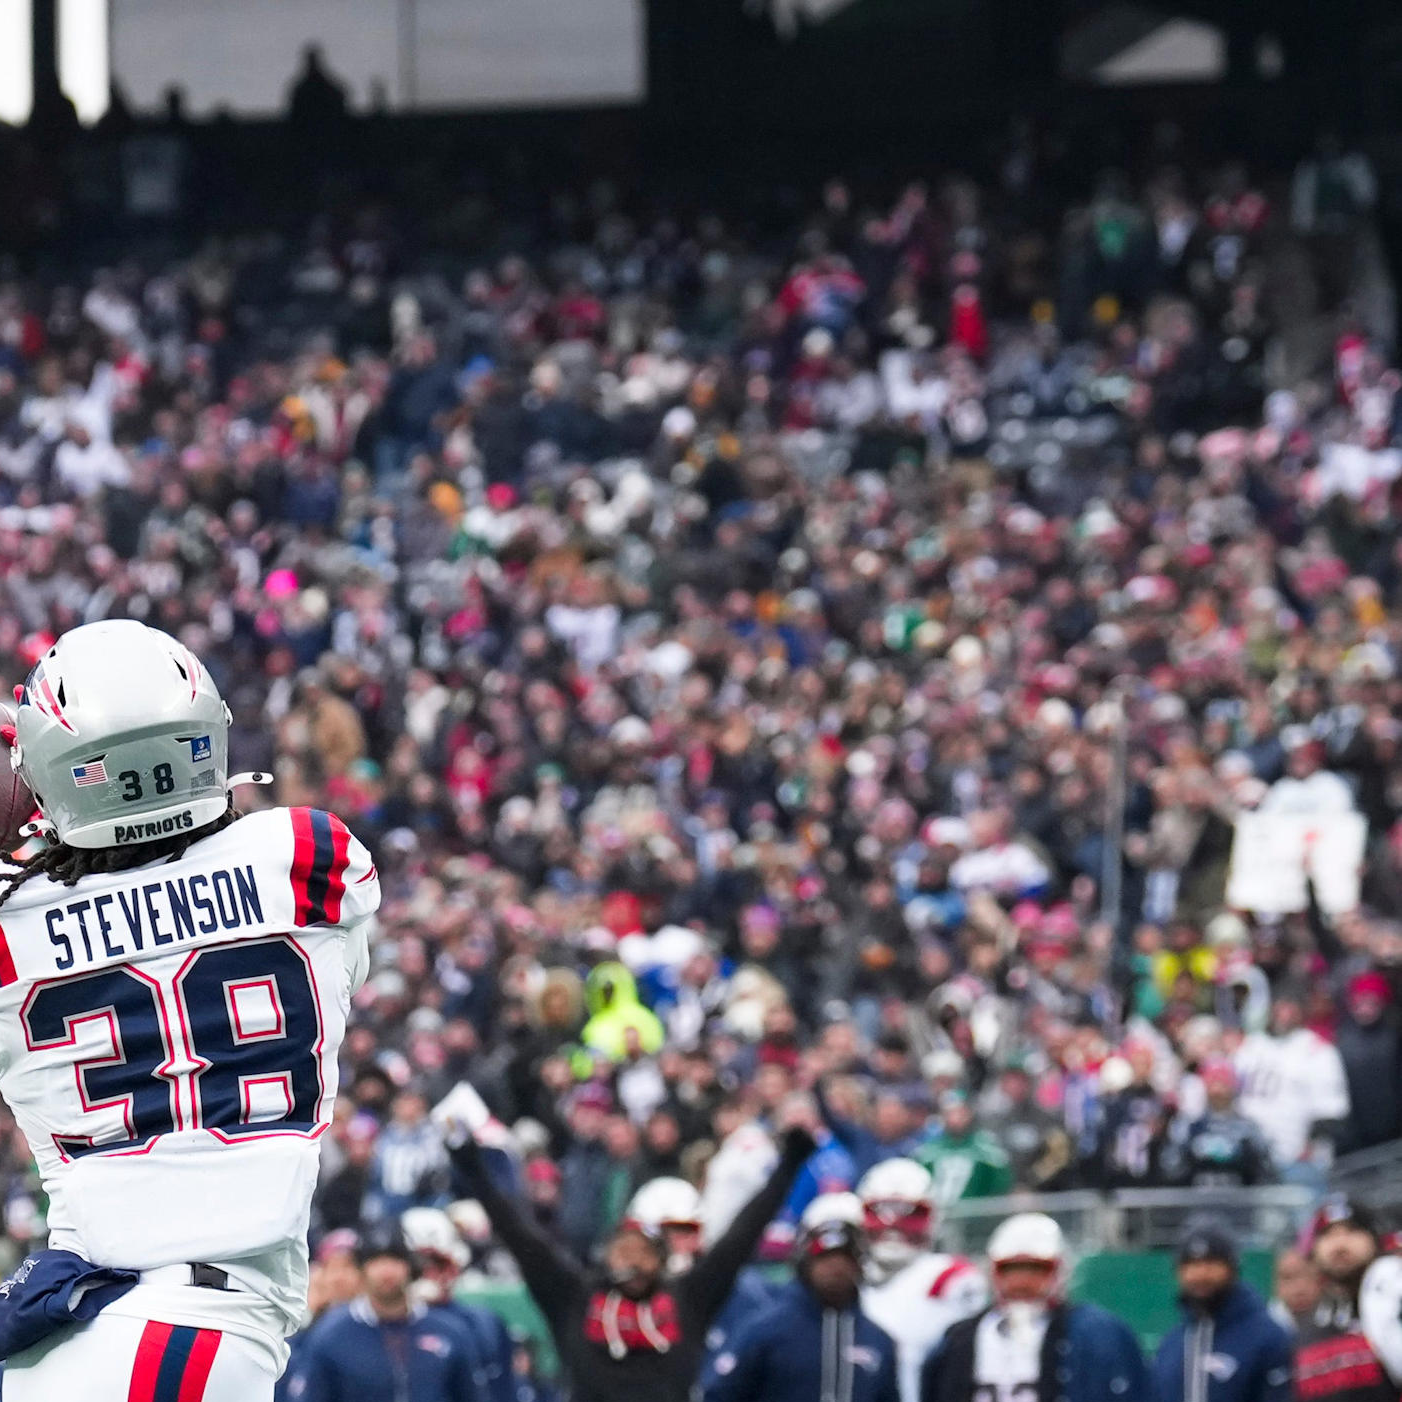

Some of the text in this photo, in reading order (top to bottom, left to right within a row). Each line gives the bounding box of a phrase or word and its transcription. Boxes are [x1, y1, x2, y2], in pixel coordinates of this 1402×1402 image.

[118, 762, 175, 802] 38
[114, 809, 194, 844] PATRIOTS
[44, 864, 265, 971] STEVENSON
[18, 932, 331, 1165] 38
